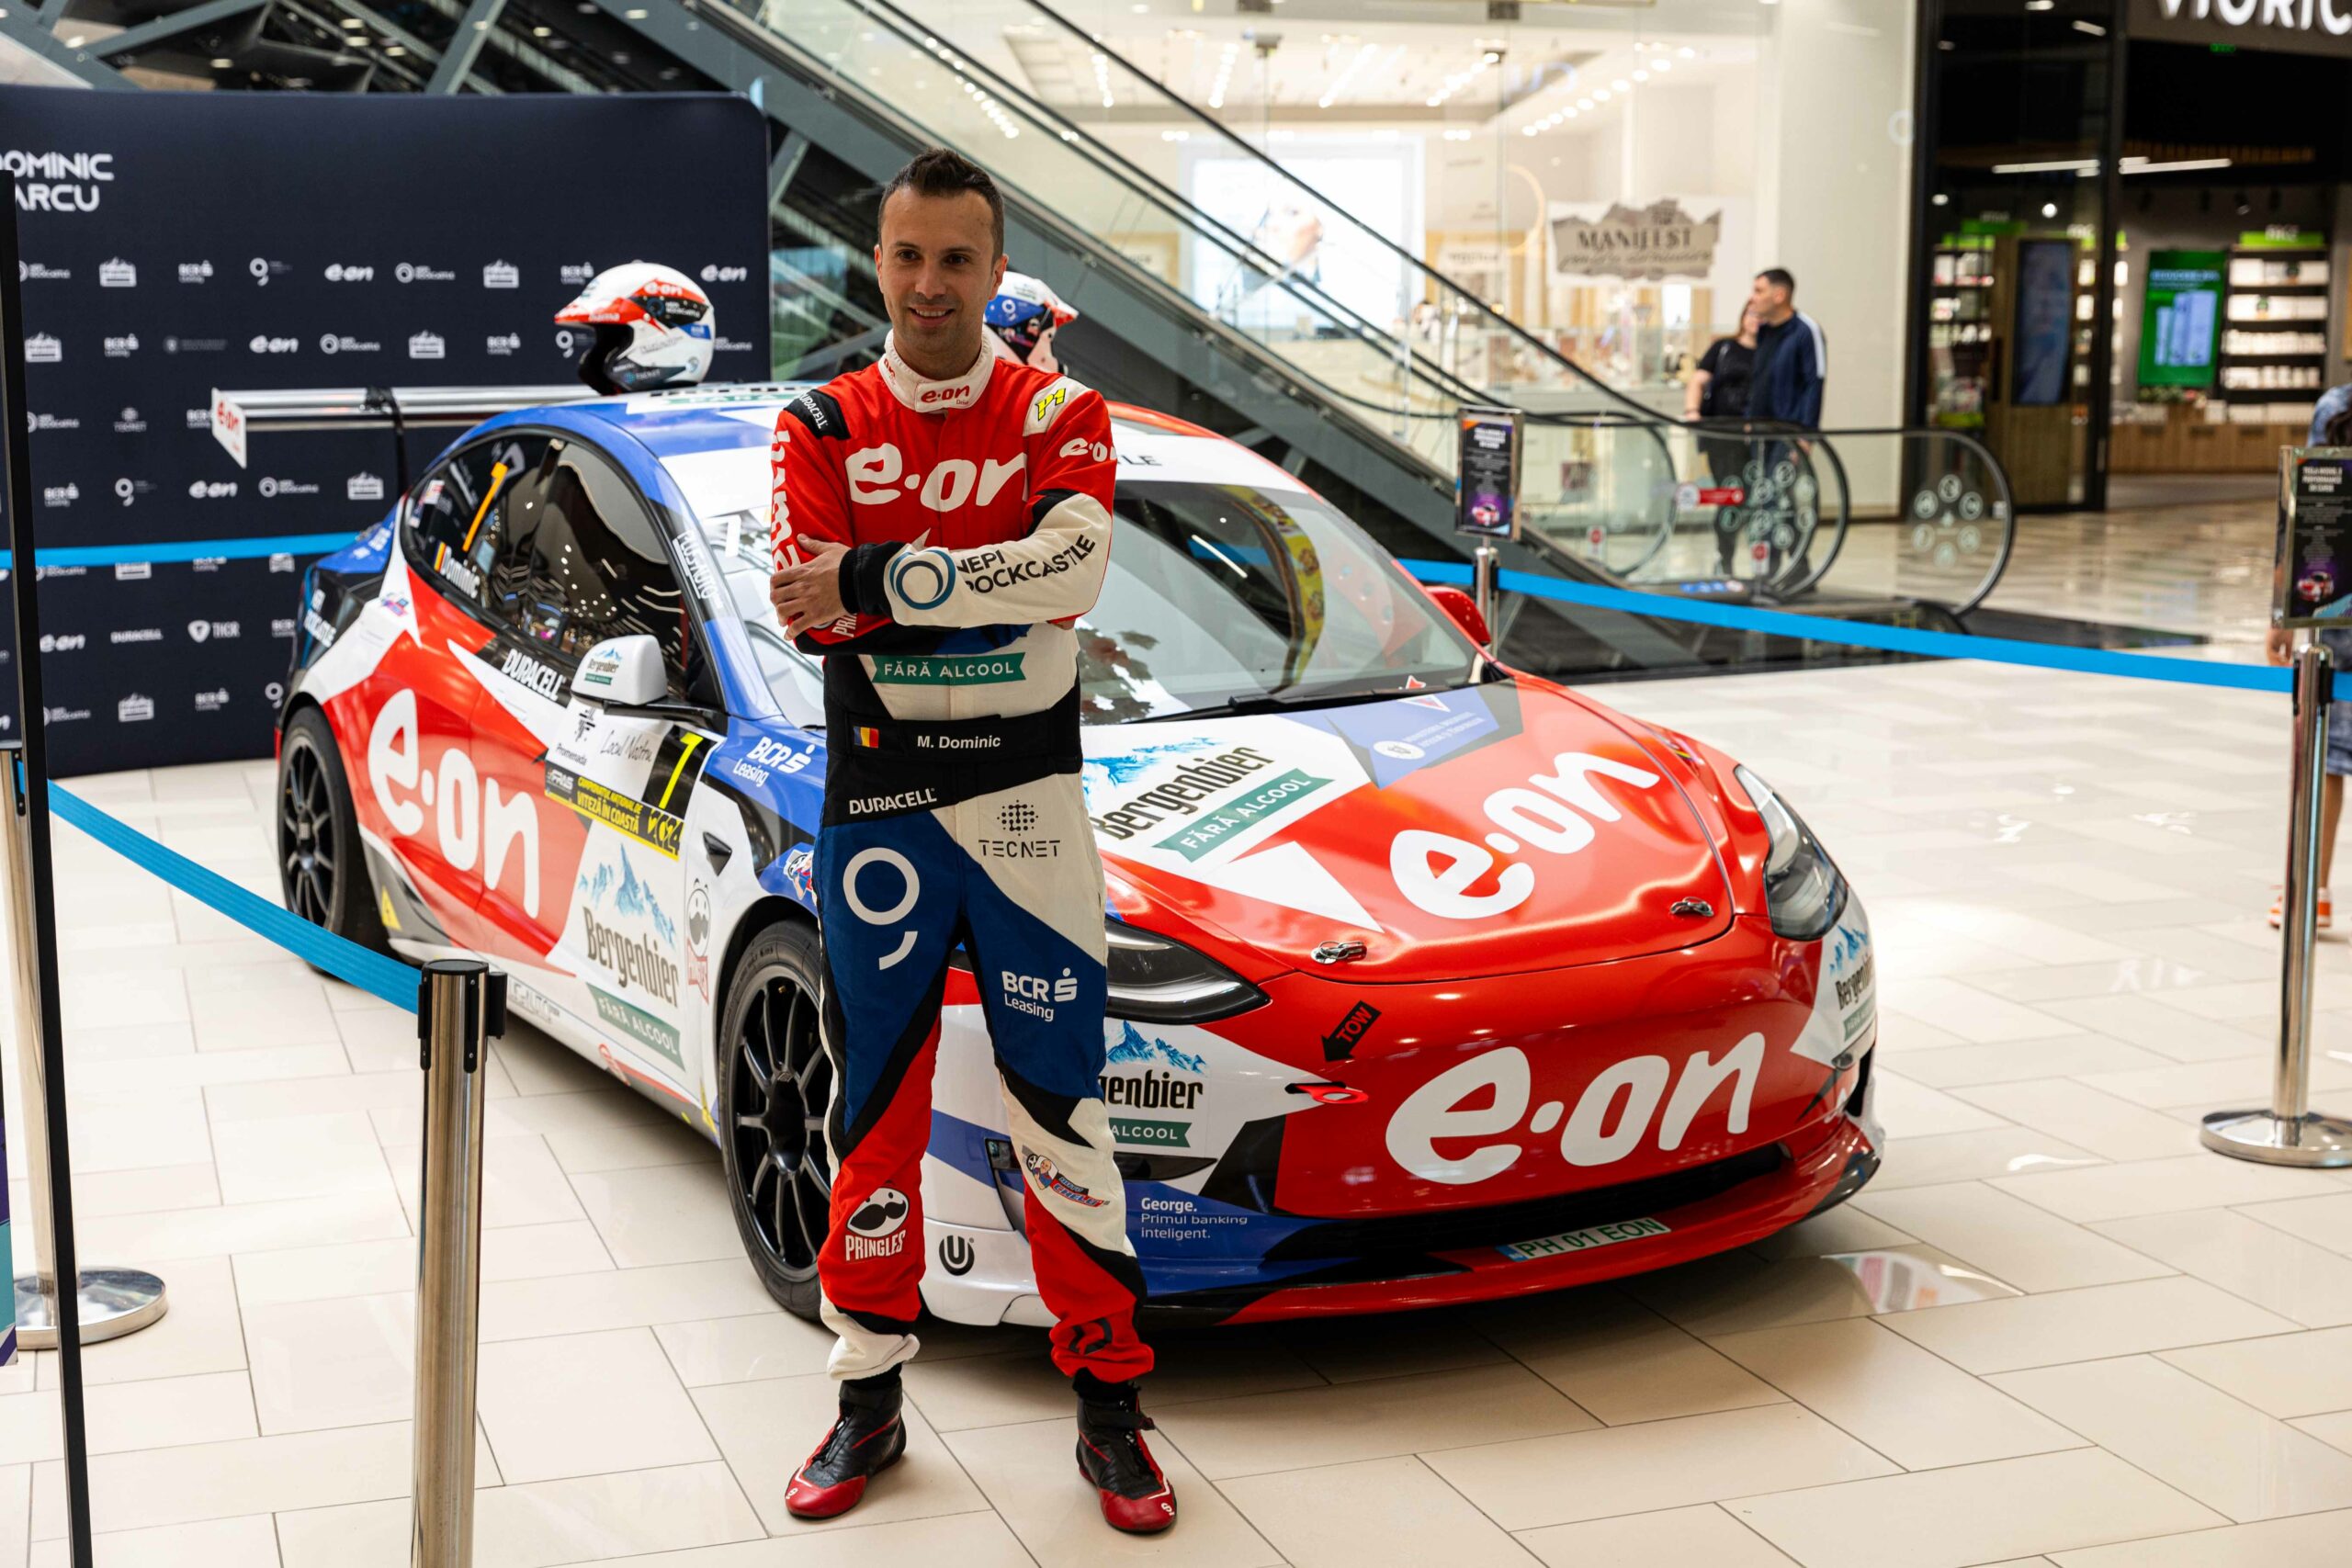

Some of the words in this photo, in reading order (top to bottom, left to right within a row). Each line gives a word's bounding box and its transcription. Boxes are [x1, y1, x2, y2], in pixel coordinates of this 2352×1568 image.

[0, 150, 114, 181] OMINIC
[15, 183, 100, 211] ARCU
[1035, 388, 1067, 422] P1
[502, 649, 566, 702] DURACELL
[884, 660, 931, 678] FĂRĂ
[939, 660, 1014, 678] ALCOOL
[747, 736, 792, 769] BCR
[917, 736, 935, 750] M.
[939, 735, 1001, 750] Dominic
[732, 759, 770, 787] Leasing
[849, 788, 937, 815] DURACELL
[1236, 778, 1311, 818] ALCOOL
[978, 840, 1060, 858] TECNET
[582, 907, 679, 1009] Bergenbier
[1001, 970, 1050, 1003] BCR
[1004, 994, 1055, 1022] Leasing
[632, 1019, 678, 1055] ALCOOL
[1336, 1006, 1373, 1042] TOW
[1111, 1124, 1178, 1140] ALCOOL
[1141, 1197, 1198, 1214] George.
[1141, 1213, 1187, 1225] Primul
[1191, 1214, 1249, 1226] banking
[845, 1230, 906, 1262] PRINGLES
[1141, 1226, 1212, 1241] inteligent.
[1516, 1239, 1565, 1258] PH
[1562, 1232, 1599, 1248] 01
[1597, 1219, 1667, 1240] EON
